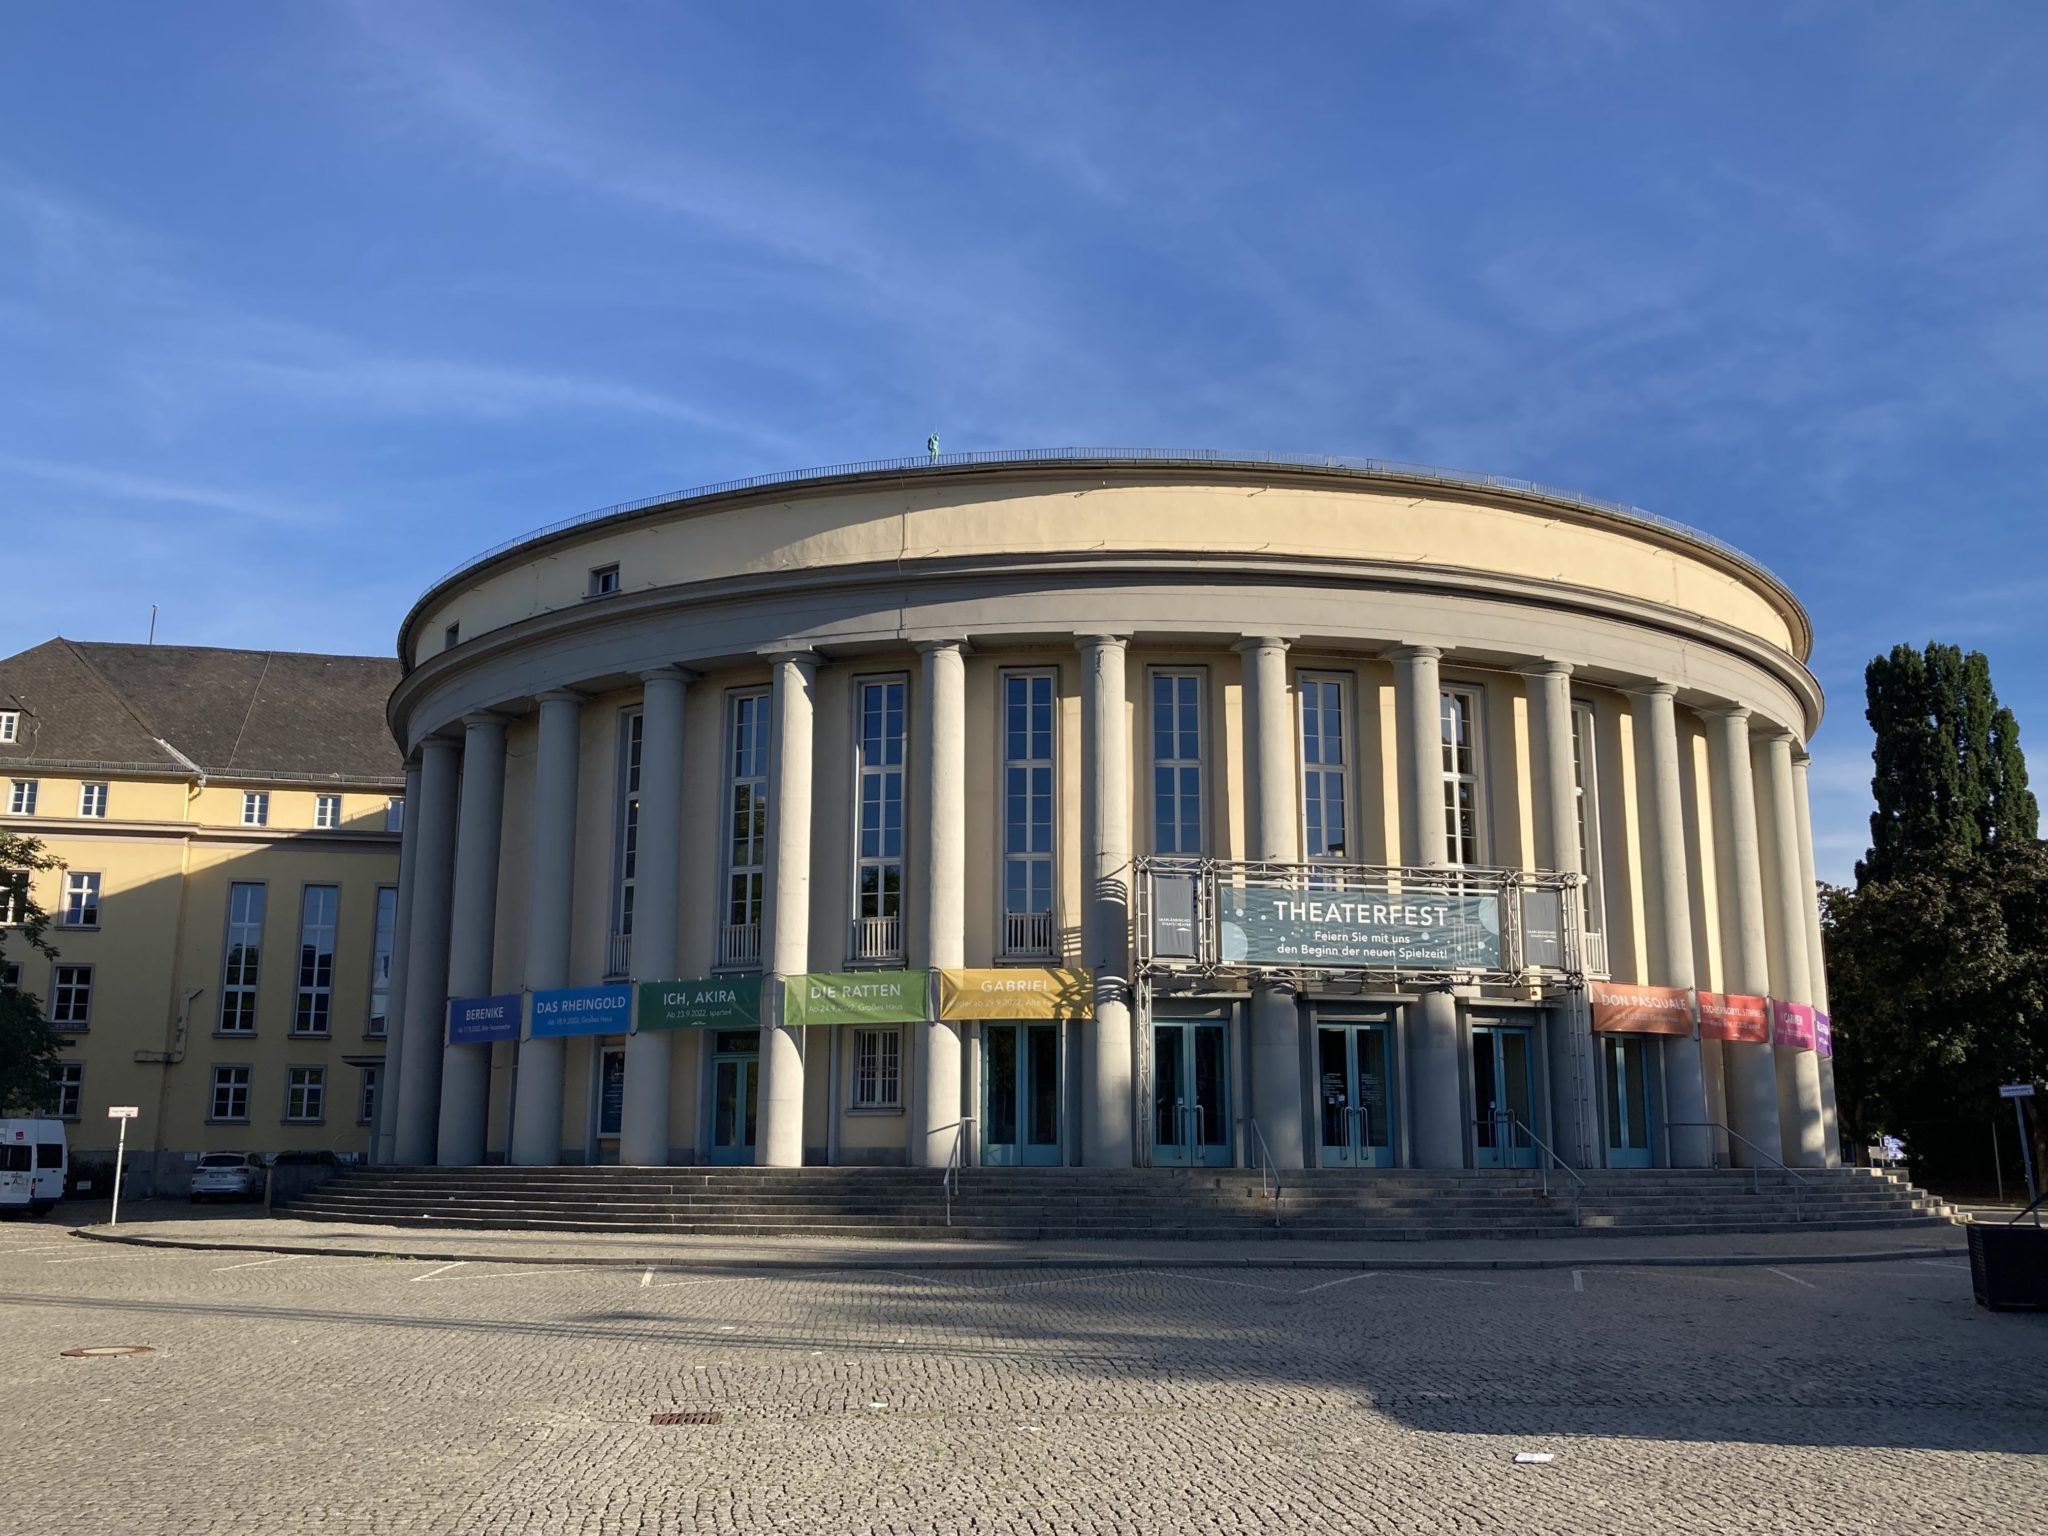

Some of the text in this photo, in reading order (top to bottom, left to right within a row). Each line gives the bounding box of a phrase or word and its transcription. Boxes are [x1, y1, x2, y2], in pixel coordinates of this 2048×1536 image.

[1273, 901, 1448, 926] THEATERFEST
[1314, 931, 1410, 944] Feiern Sie mit uns
[1277, 943, 1448, 960] den Beginn der neuen Spielzeit!
[811, 984, 901, 999] DIE RATTEN
[980, 980, 1049, 992] GABRIEL
[537, 996, 626, 1014] DAS RHEINGOLD
[663, 990, 737, 1006] ICH, AKIRA
[1601, 994, 1687, 1010] DON PASQUALE
[465, 1006, 504, 1021] BERENIKE
